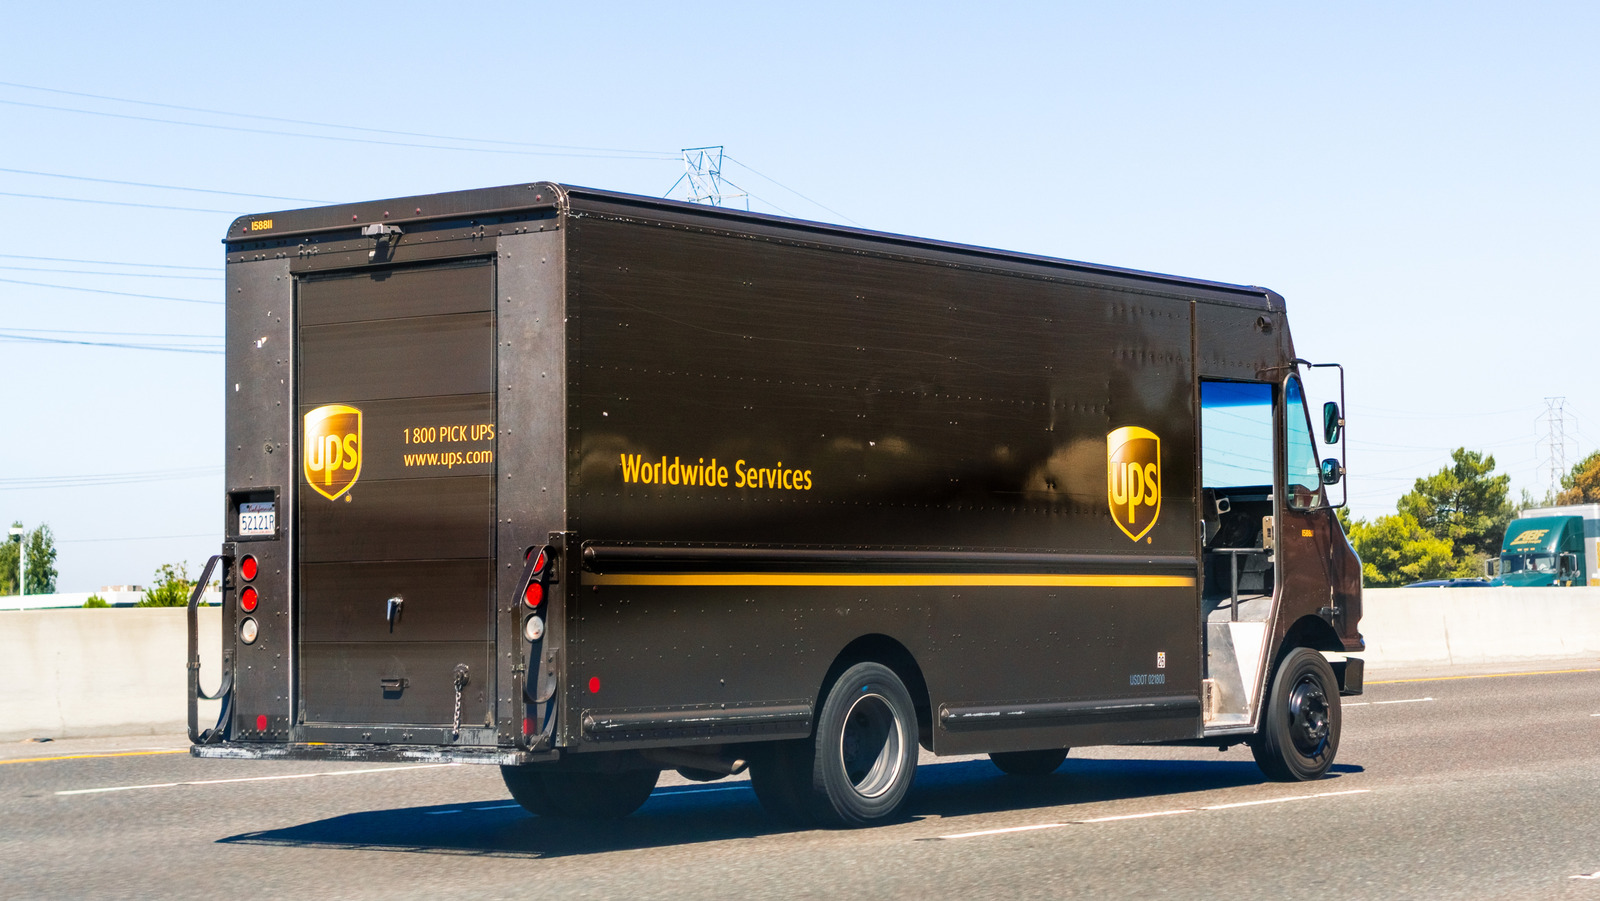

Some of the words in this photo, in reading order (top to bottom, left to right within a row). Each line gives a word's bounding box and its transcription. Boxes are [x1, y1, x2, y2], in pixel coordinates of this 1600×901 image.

[251, 219, 273, 231] 158811
[403, 428, 409, 444] 1
[412, 427, 436, 444] 800
[439, 425, 468, 442] PICK
[470, 423, 495, 441] UPS
[403, 450, 493, 470] www.ups.com
[620, 453, 729, 488] Worldwide
[735, 459, 812, 491] Services
[1130, 674, 1147, 685] USDOT
